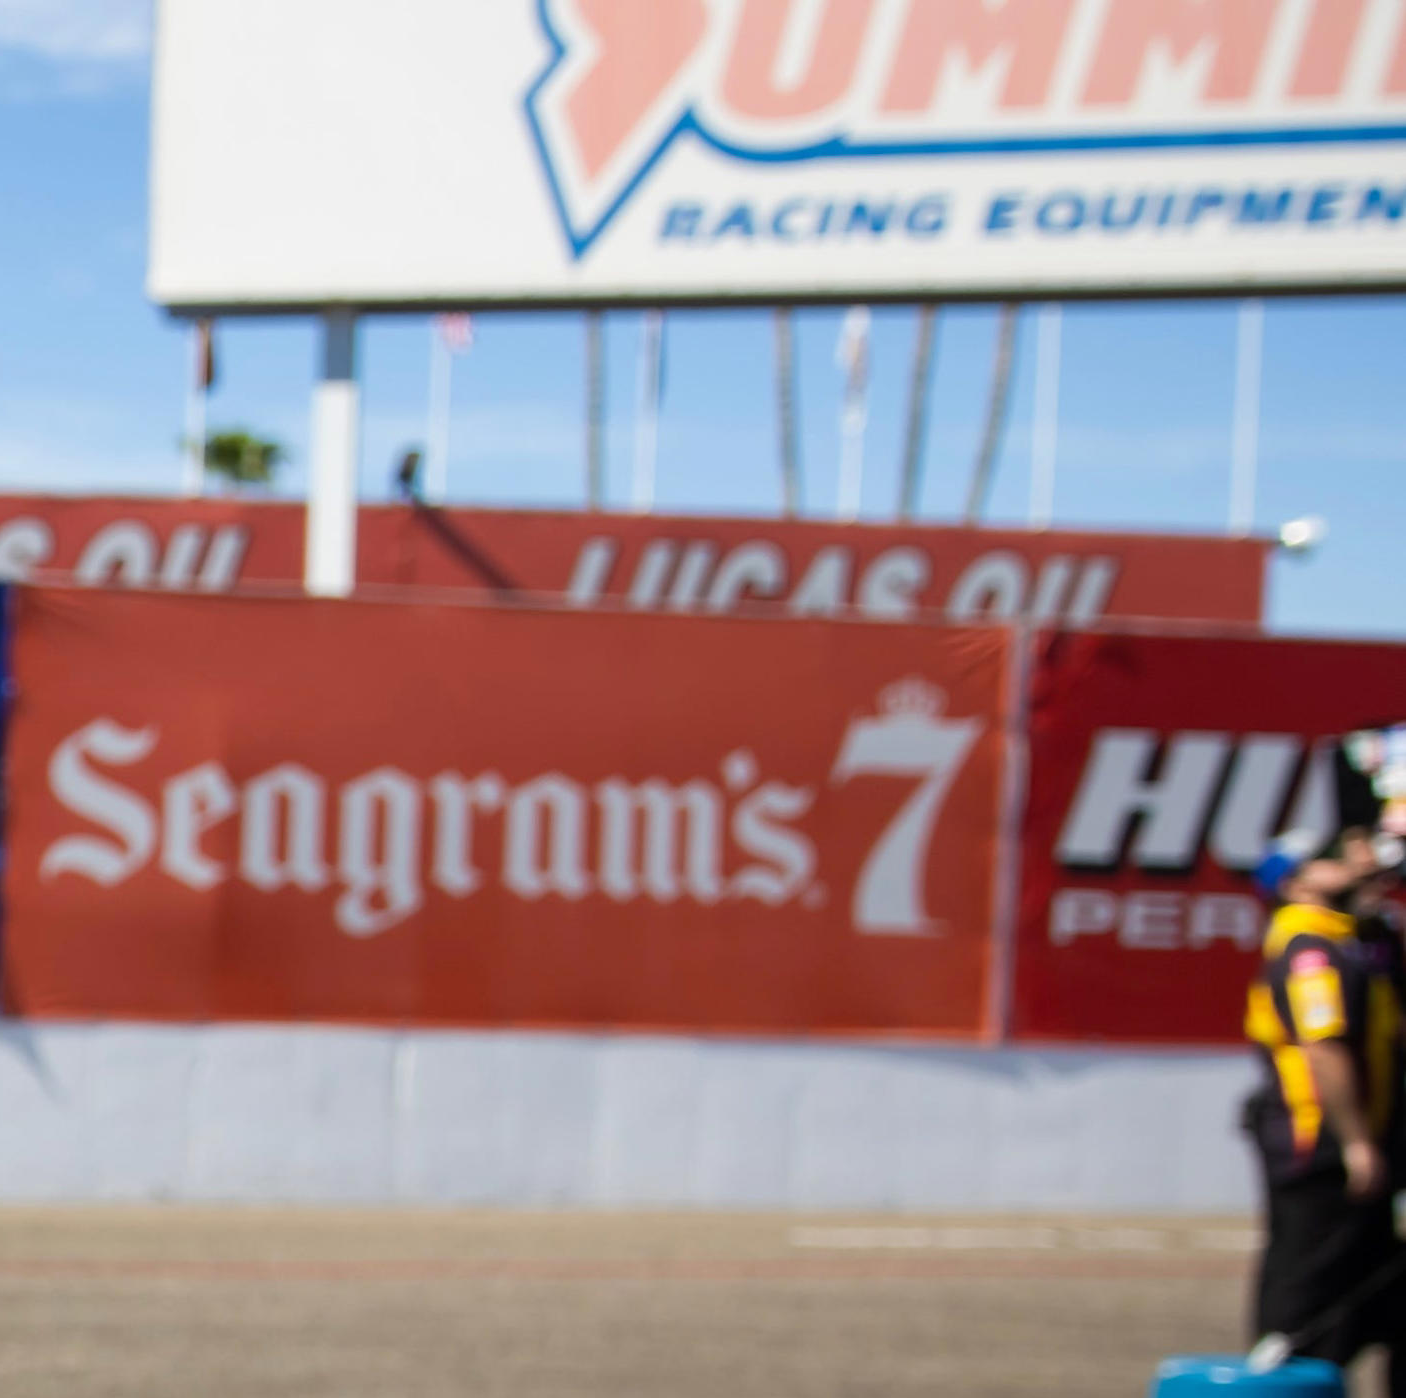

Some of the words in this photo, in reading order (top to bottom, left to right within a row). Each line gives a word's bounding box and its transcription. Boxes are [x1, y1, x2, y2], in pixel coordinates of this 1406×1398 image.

[561, 0, 1406, 183] SUMMI
[657, 194, 948, 247] RACING
[984, 178, 1406, 236] EQUIPMEN
[37, 716, 819, 938] Seagram's
[831, 714, 985, 937] 7
[1055, 727, 1342, 872] HU
